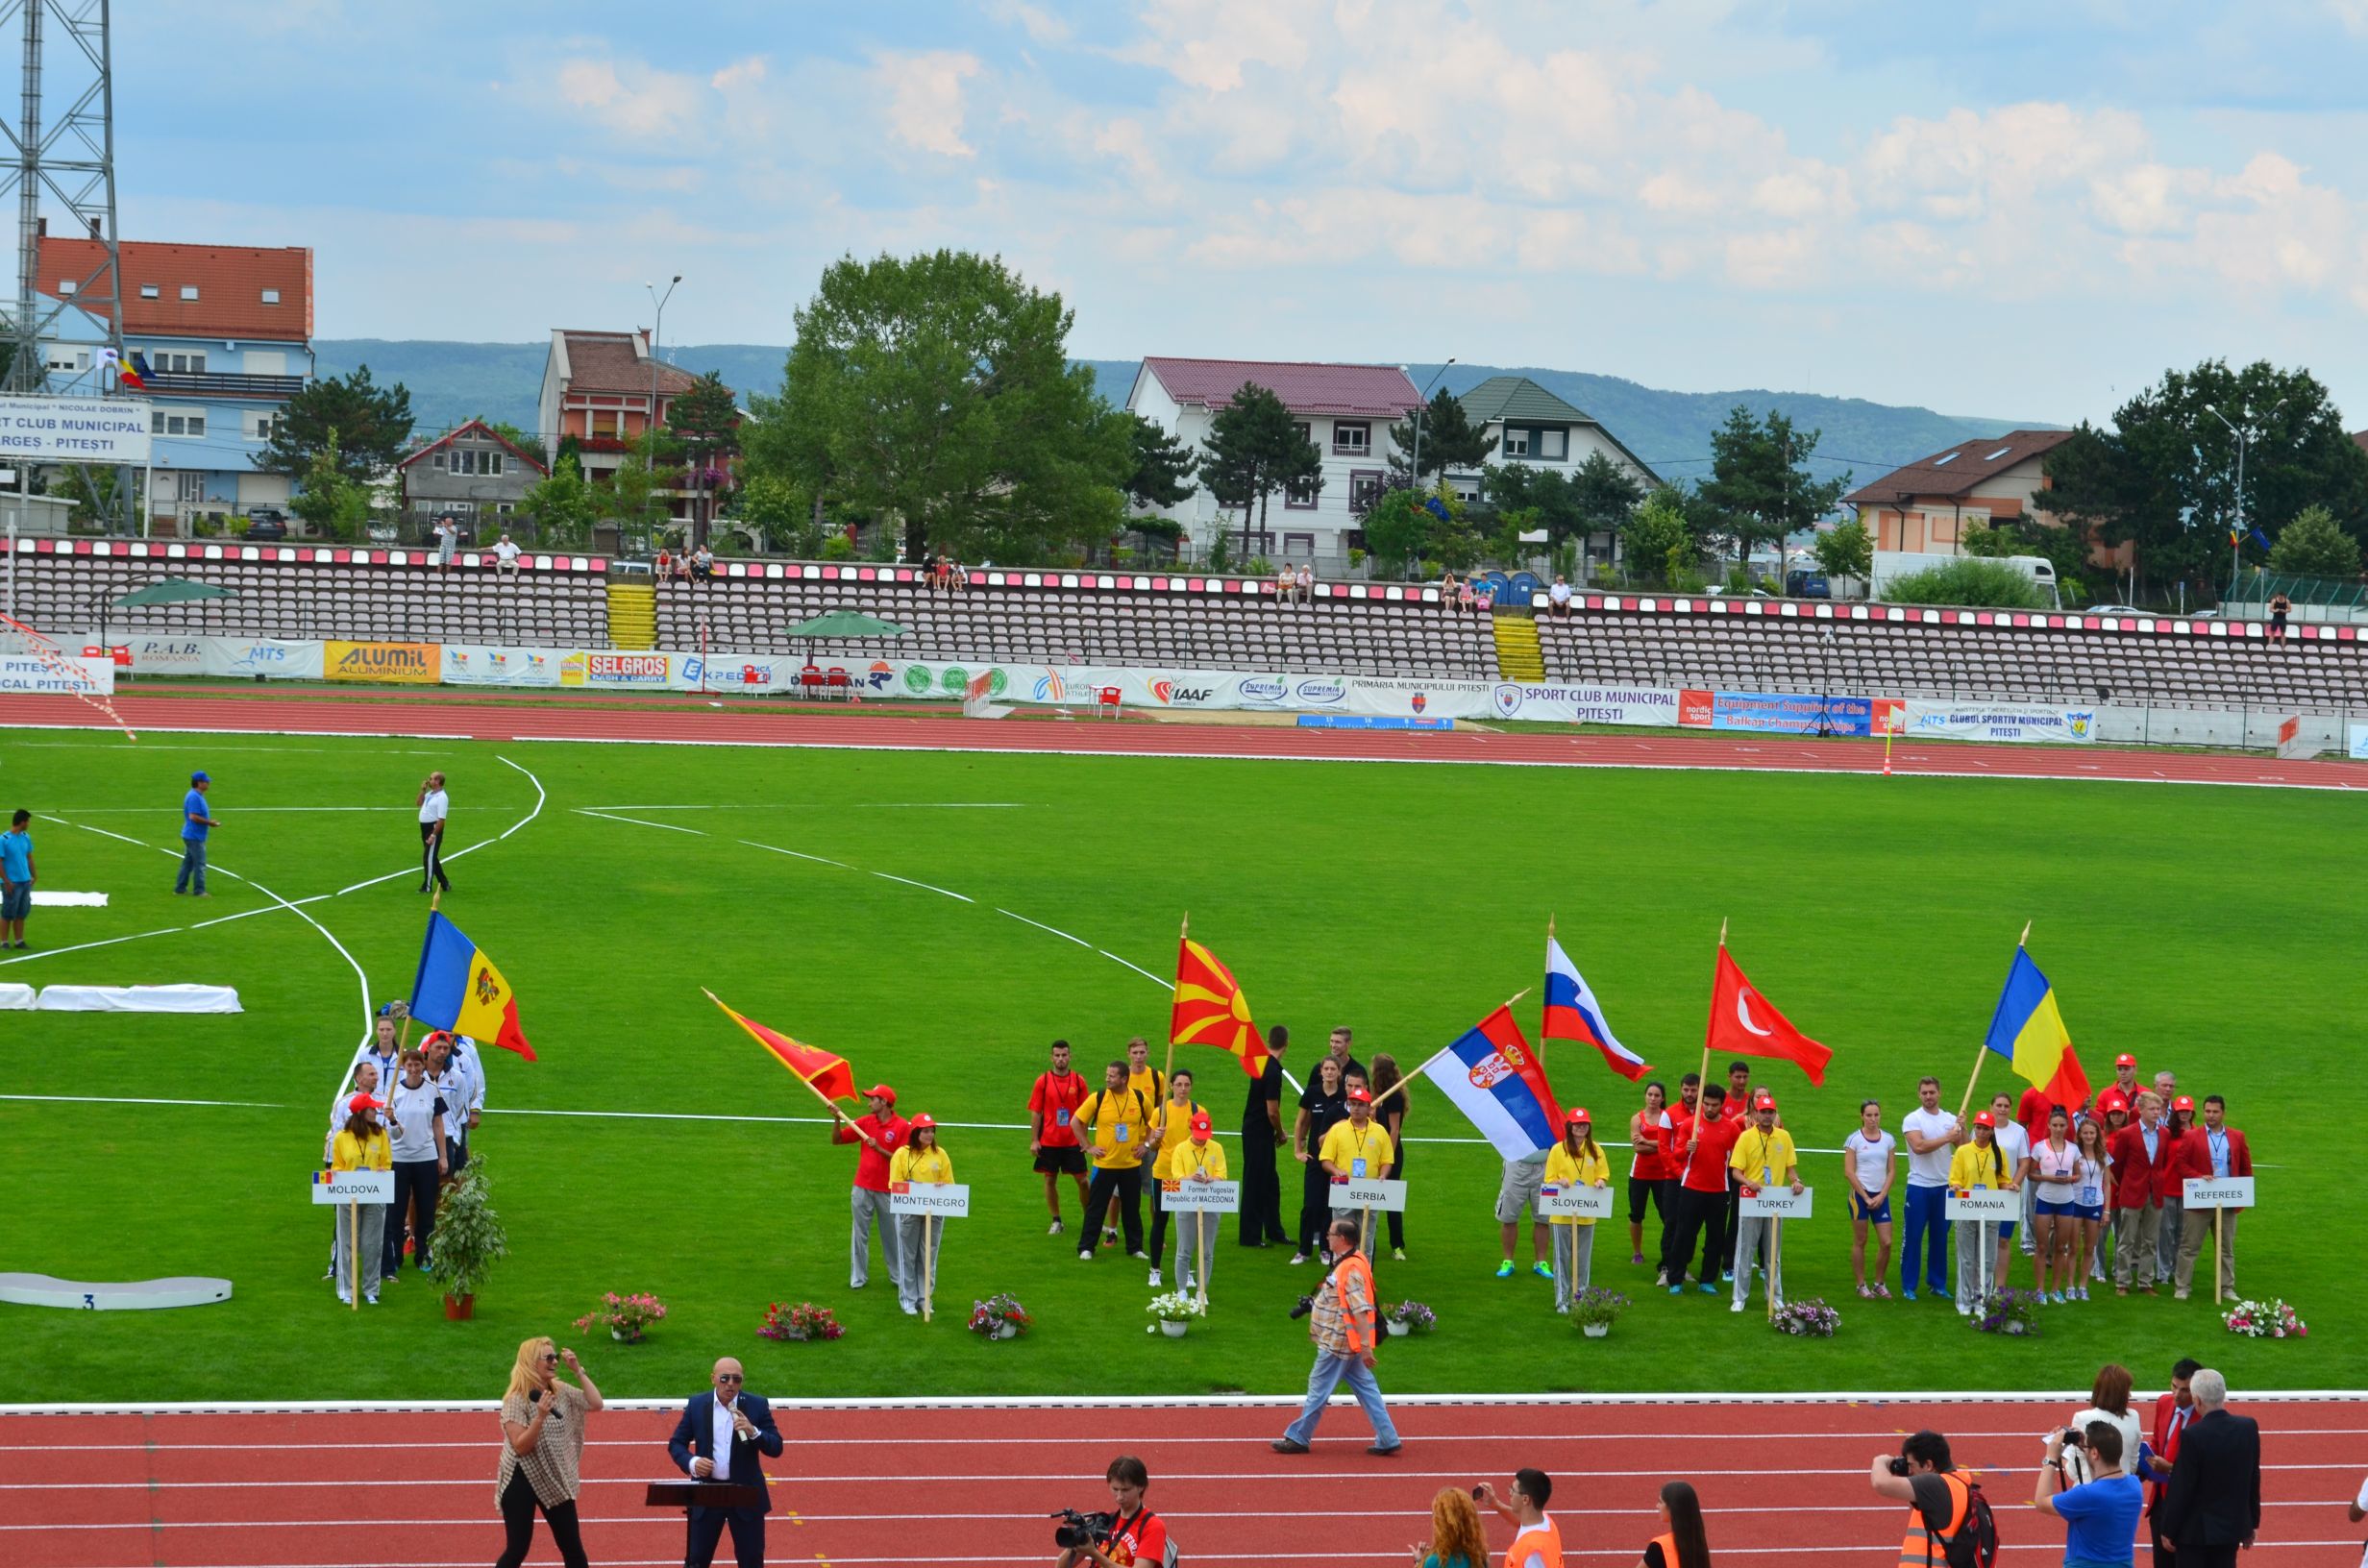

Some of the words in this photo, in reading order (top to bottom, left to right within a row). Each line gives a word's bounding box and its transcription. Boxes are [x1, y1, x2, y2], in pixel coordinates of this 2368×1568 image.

[59, 404, 96, 413] NICOLAE
[16, 417, 57, 429] CLUB
[62, 420, 145, 433] MUNICIPAL
[0, 435, 42, 450] RGEȘ
[144, 642, 201, 654] P.A.B.
[591, 656, 666, 674] SELGROS
[337, 666, 427, 676] ALUMINIUM
[0, 678, 31, 689] CAL
[1397, 681, 1455, 692] MUNICIPIULUI
[1174, 689, 1213, 700] IAAF
[1525, 688, 1566, 700] SPORT
[1569, 689, 1602, 702] CLUB
[1605, 692, 1676, 706] MUNICIPAL
[1717, 698, 1780, 713] Equipment
[1832, 702, 1845, 714] of
[1846, 703, 1866, 715] the
[1690, 714, 1712, 723] sport
[1726, 715, 1764, 726] Balkan
[1950, 714, 1980, 724] CLUBUL
[1982, 715, 2016, 724] SPORTIV
[2018, 716, 2062, 726] MUNICIPAL
[328, 1185, 380, 1194] MOLDOVA
[1210, 1187, 1235, 1195] Yugoslav
[2194, 1190, 2243, 1199] REFEREES
[1166, 1194, 1190, 1203] Republic
[1349, 1191, 1386, 1201] SERBIA
[893, 1196, 966, 1208] MONTENEGRO
[1551, 1198, 1599, 1209] SLOVENIA
[1757, 1200, 1794, 1209] TURKEY
[1961, 1200, 2005, 1209] ROMANIA
[83, 1294, 94, 1310] 3
